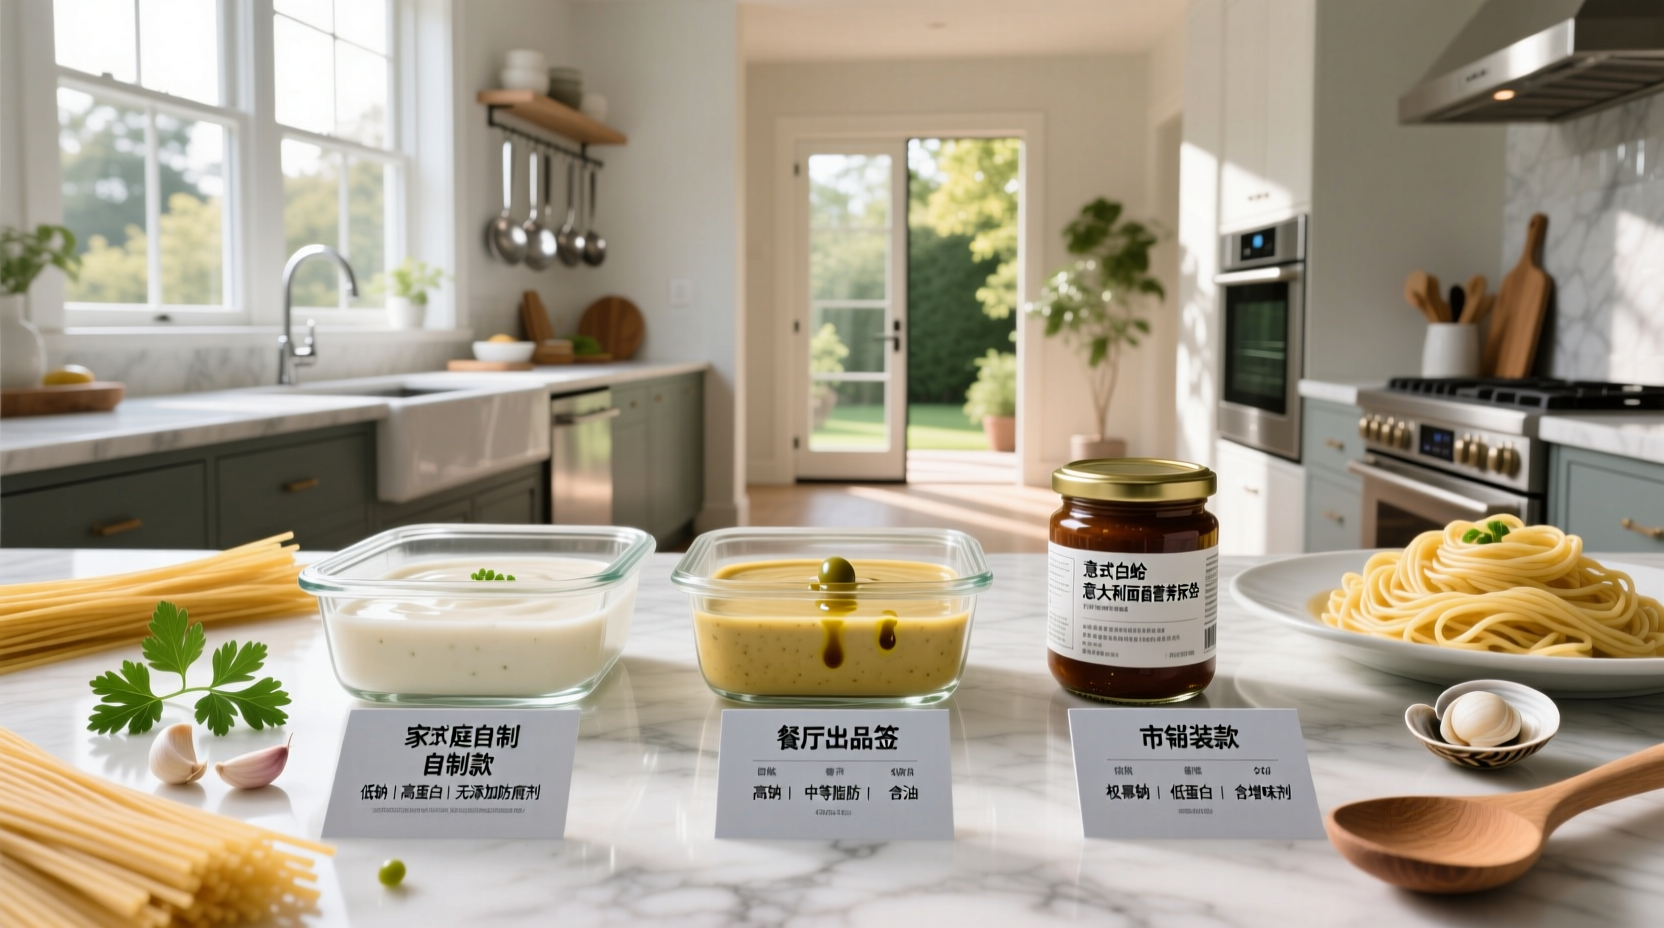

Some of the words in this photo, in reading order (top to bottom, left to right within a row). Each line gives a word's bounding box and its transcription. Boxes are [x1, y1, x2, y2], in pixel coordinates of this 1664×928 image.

[777, 724, 899, 750] 餐厅出品签
[424, 752, 494, 776] 自制款
